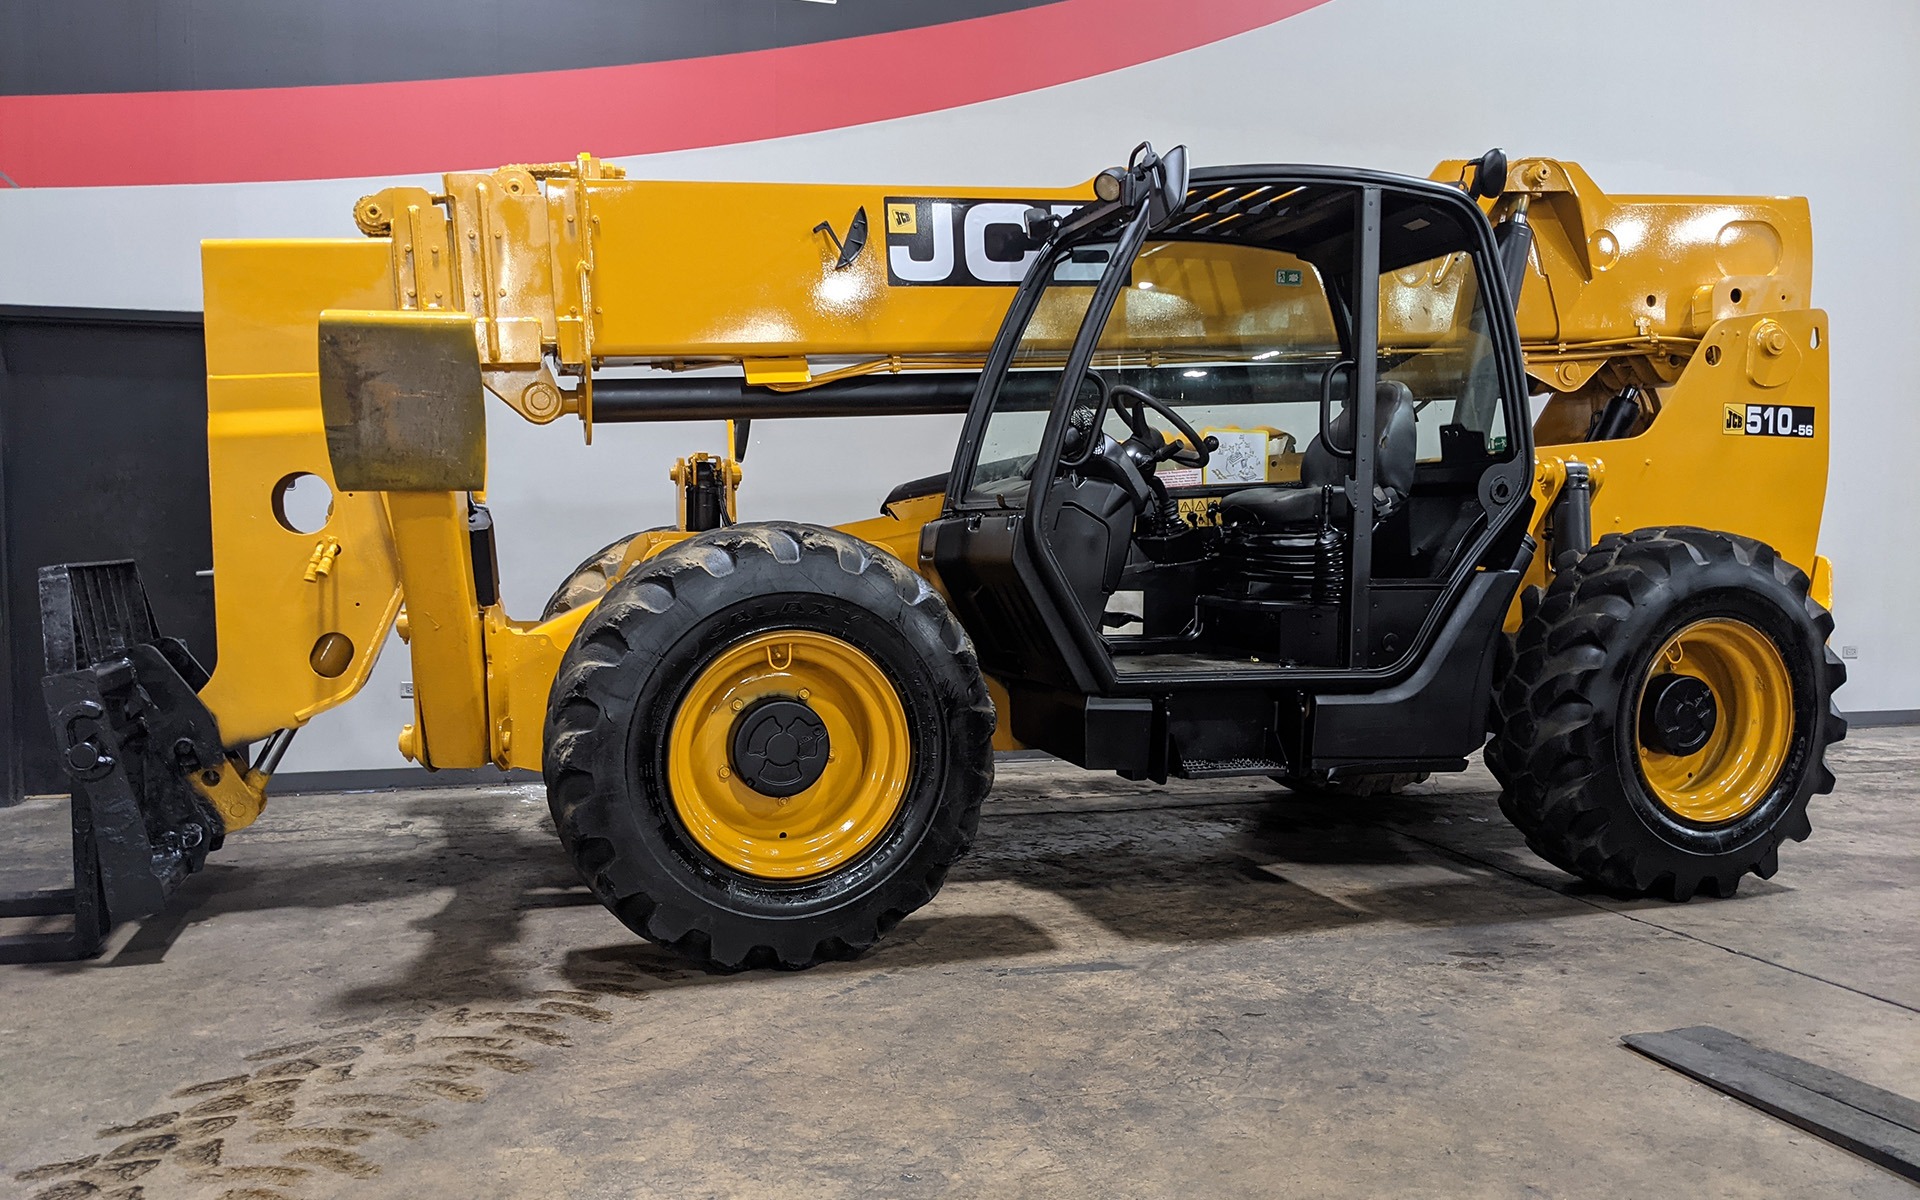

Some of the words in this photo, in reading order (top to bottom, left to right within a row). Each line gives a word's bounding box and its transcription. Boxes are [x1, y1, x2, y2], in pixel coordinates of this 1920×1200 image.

[895, 211, 911, 226] JCB
[1726, 410, 1743, 429] JCB
[1746, 406, 1813, 436] 510-56
[708, 601, 864, 640] GALAXY
